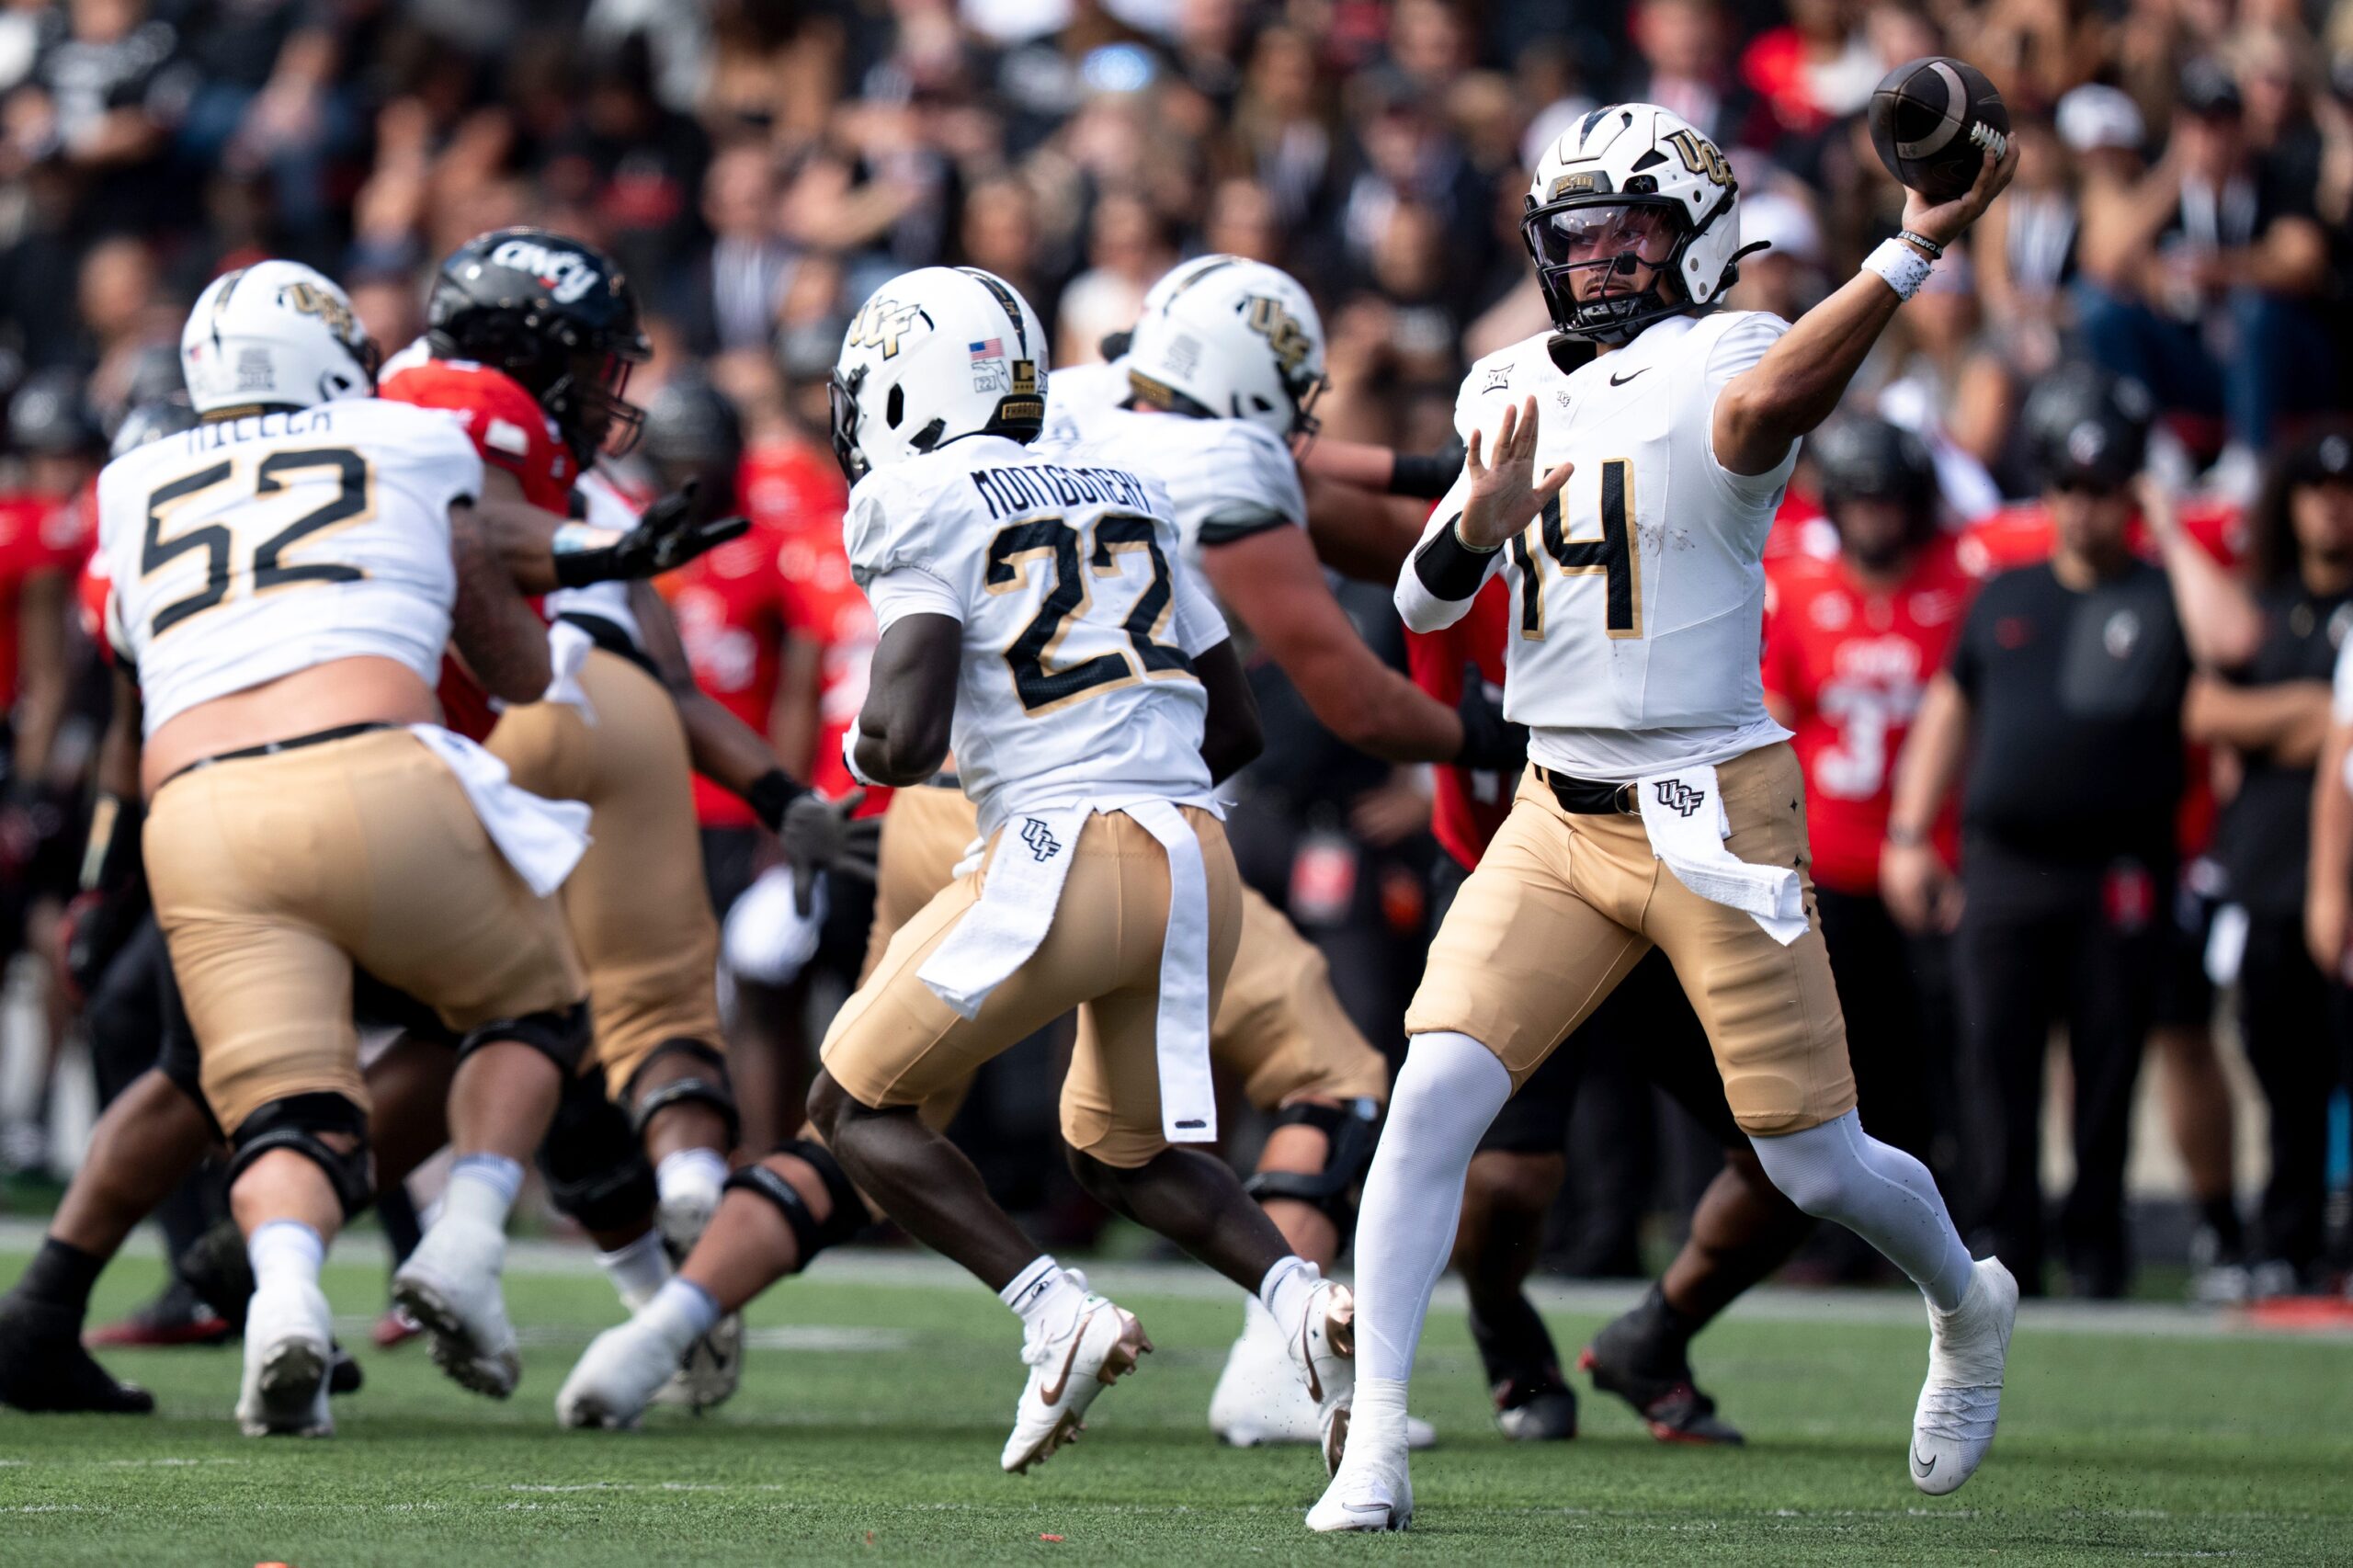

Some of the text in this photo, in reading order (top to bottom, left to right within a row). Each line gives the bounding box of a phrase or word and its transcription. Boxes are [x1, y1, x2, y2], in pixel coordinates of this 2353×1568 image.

[1909, 233, 1937, 251] CARES
[849, 294, 920, 360] UCF
[970, 464, 1153, 520] MONTGOMERY
[141, 446, 377, 642] 52
[1511, 458, 1643, 641] 14
[984, 511, 1202, 720] 22
[1653, 778, 1705, 818] UCF
[1020, 817, 1062, 862] UCF
